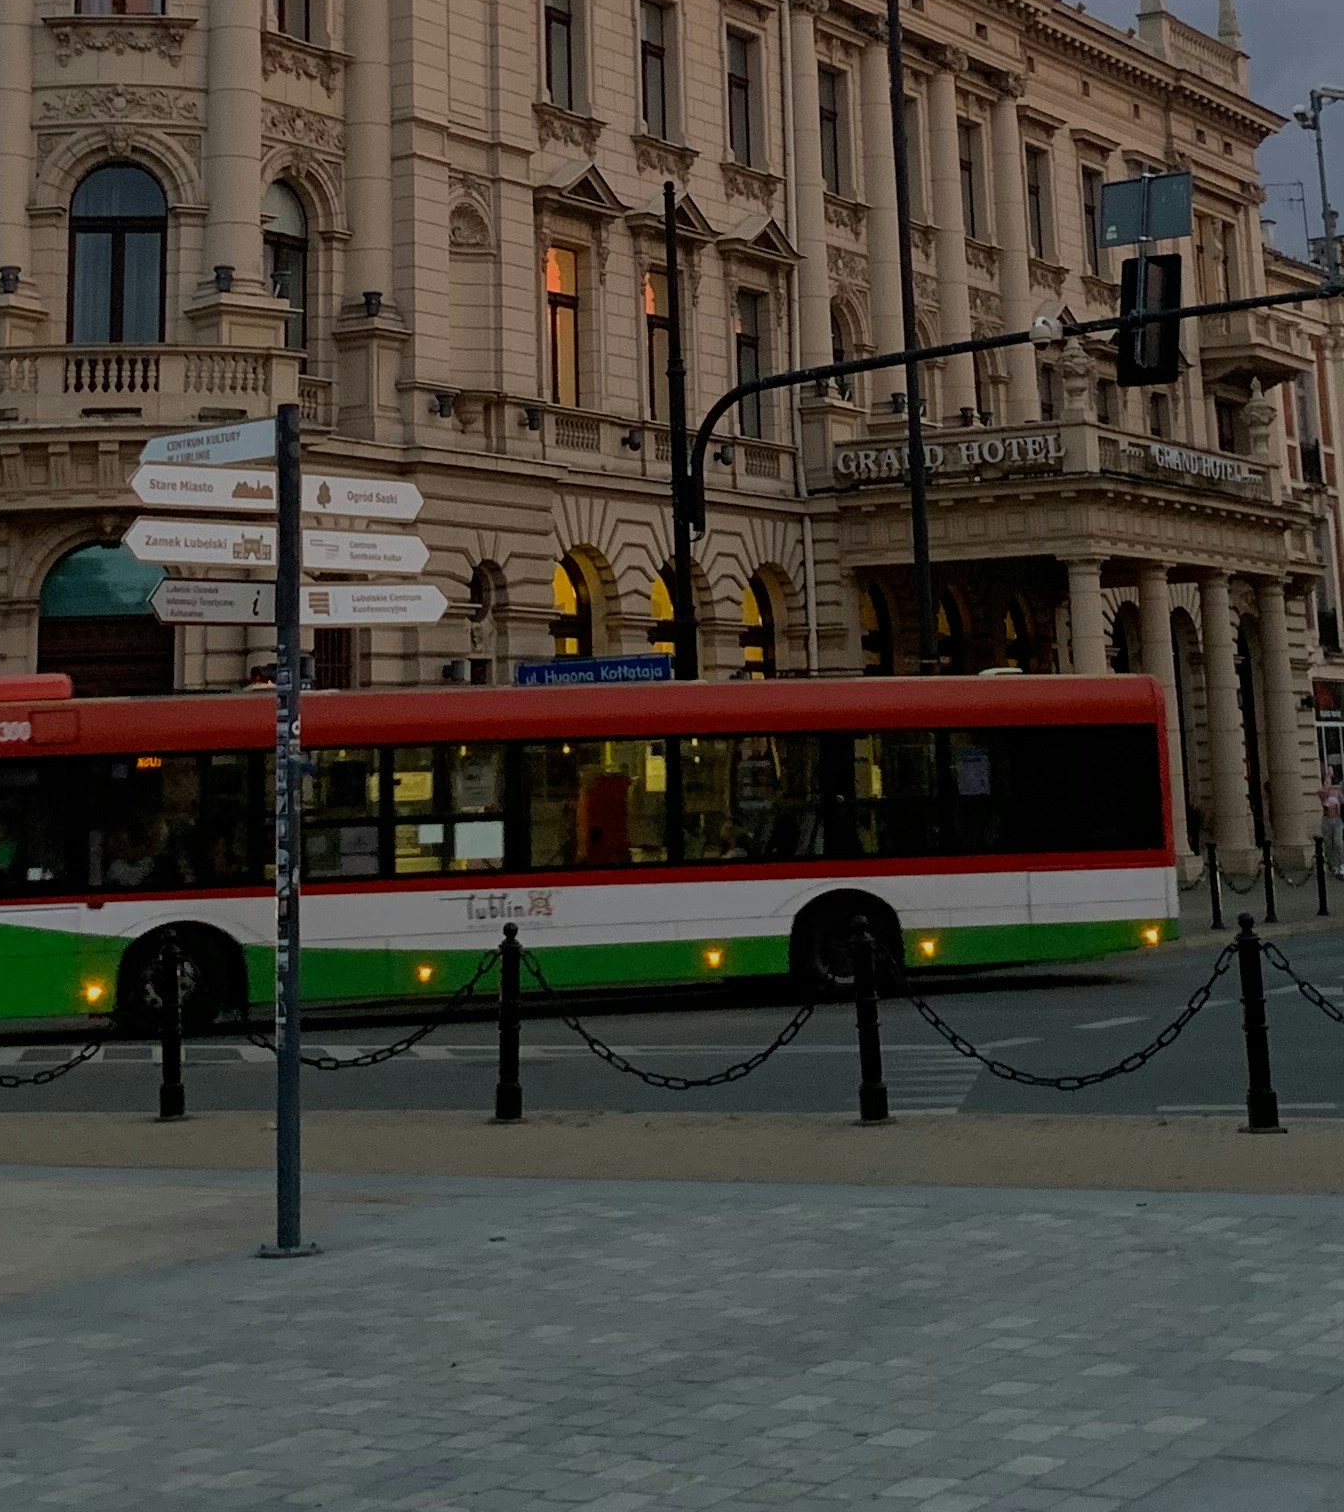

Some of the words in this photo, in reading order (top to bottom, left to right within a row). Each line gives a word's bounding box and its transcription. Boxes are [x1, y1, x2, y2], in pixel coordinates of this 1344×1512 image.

[167, 437, 204, 451] CENTRUM
[206, 431, 241, 447] KULTURY
[836, 445, 944, 474] GRAD
[958, 434, 1067, 464] HOTEL
[1156, 447, 1199, 475] GRAND
[1202, 455, 1243, 482] HOTEL
[149, 478, 177, 490] Stare
[180, 480, 214, 492] Miasto
[347, 491, 374, 504] Ogród
[376, 492, 398, 504] Saski
[145, 535, 181, 547] Zamek
[184, 538, 227, 549] Lubelski
[389, 593, 422, 601] Centrum
